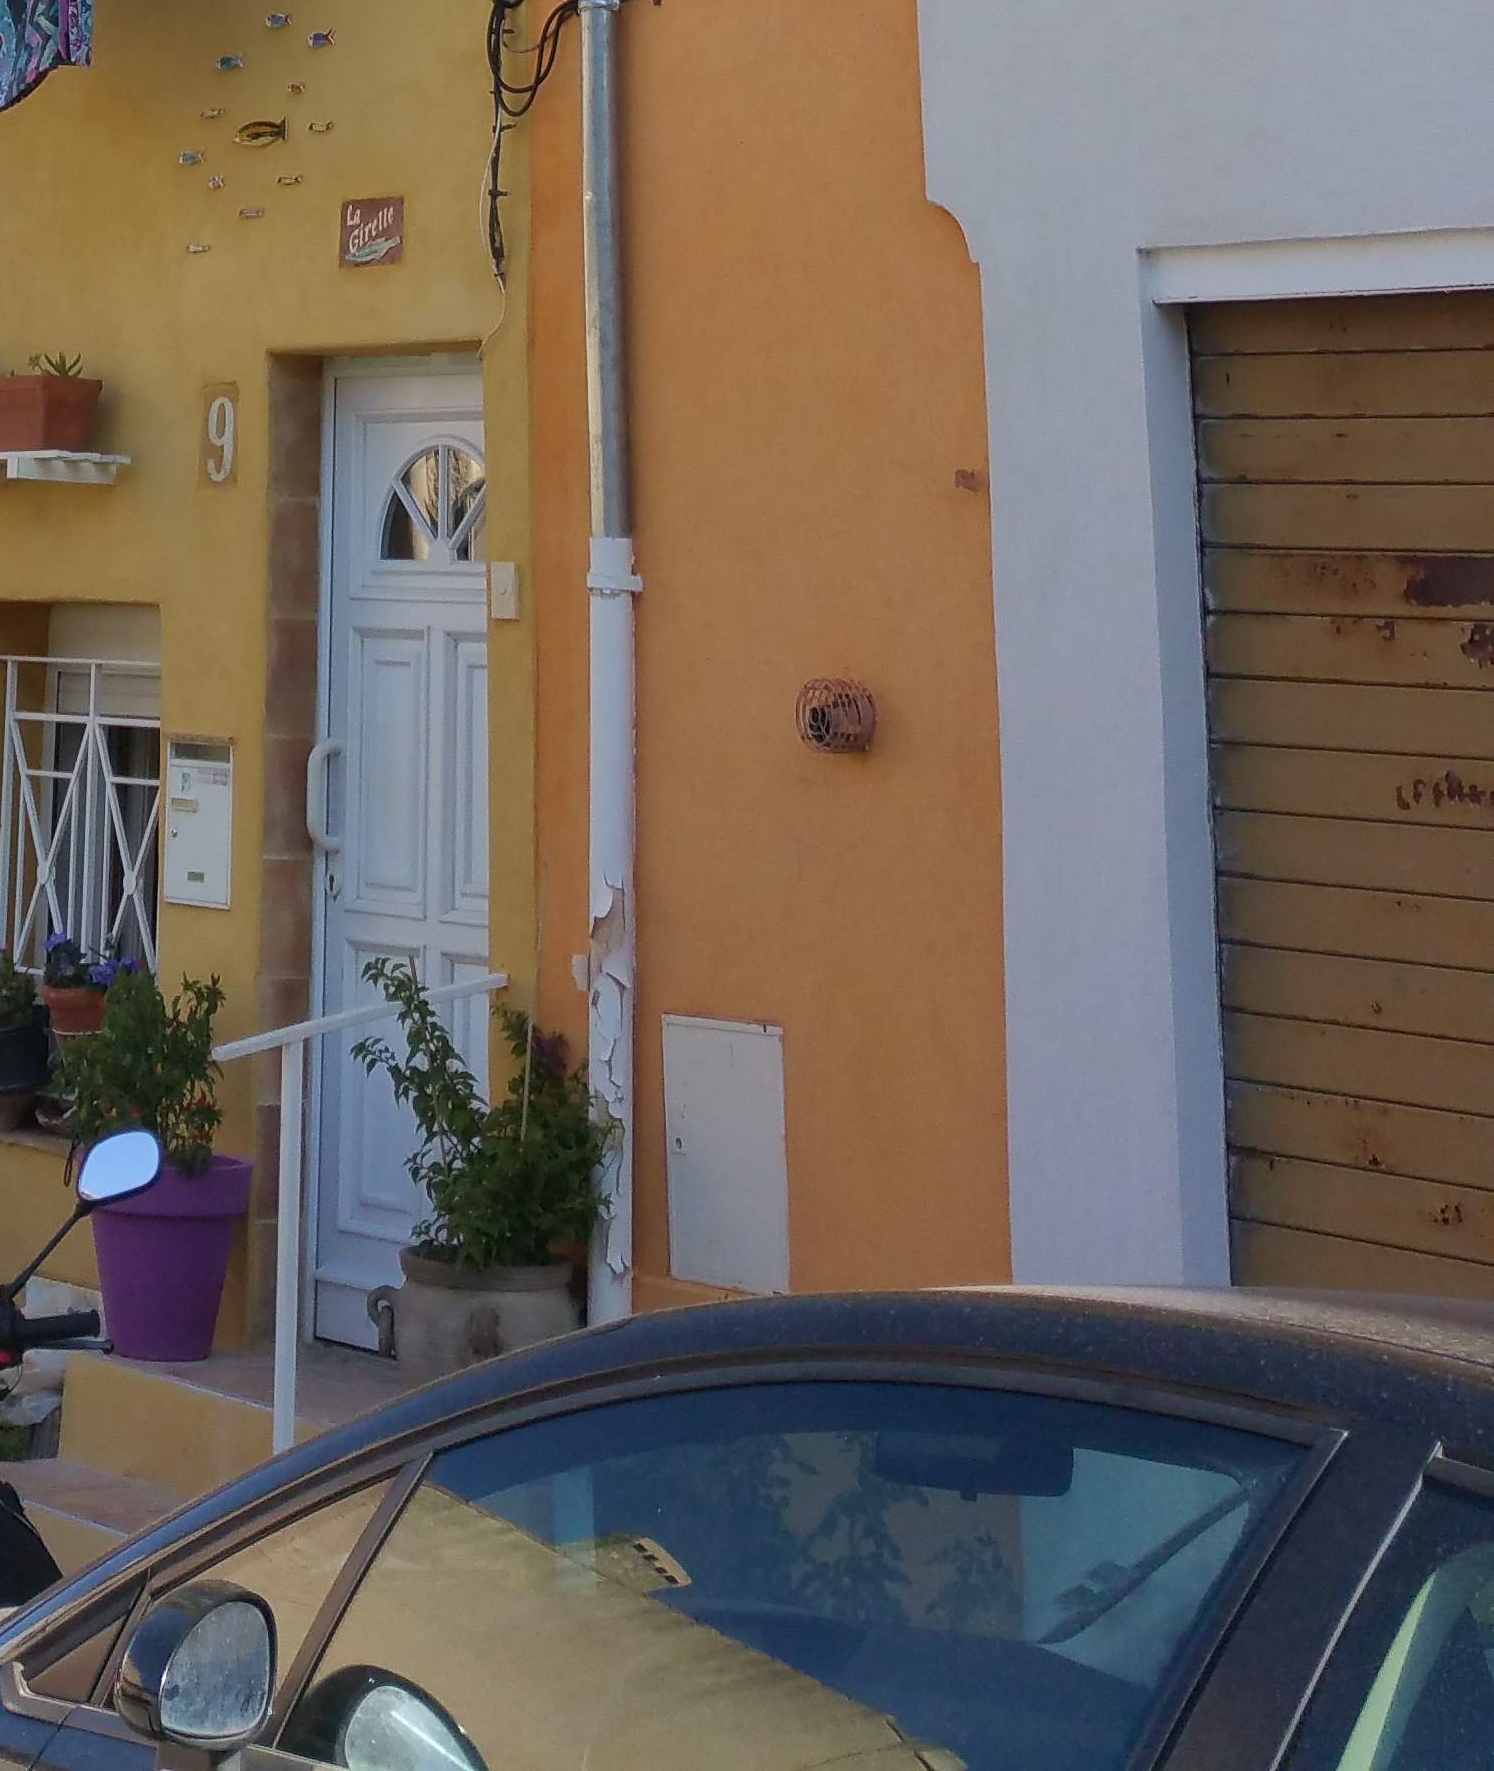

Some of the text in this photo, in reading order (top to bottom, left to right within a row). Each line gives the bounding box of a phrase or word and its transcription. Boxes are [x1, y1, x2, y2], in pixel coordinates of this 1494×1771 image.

[347, 204, 361, 227] La
[349, 206, 394, 254] Girelle
[207, 396, 234, 482] 9
